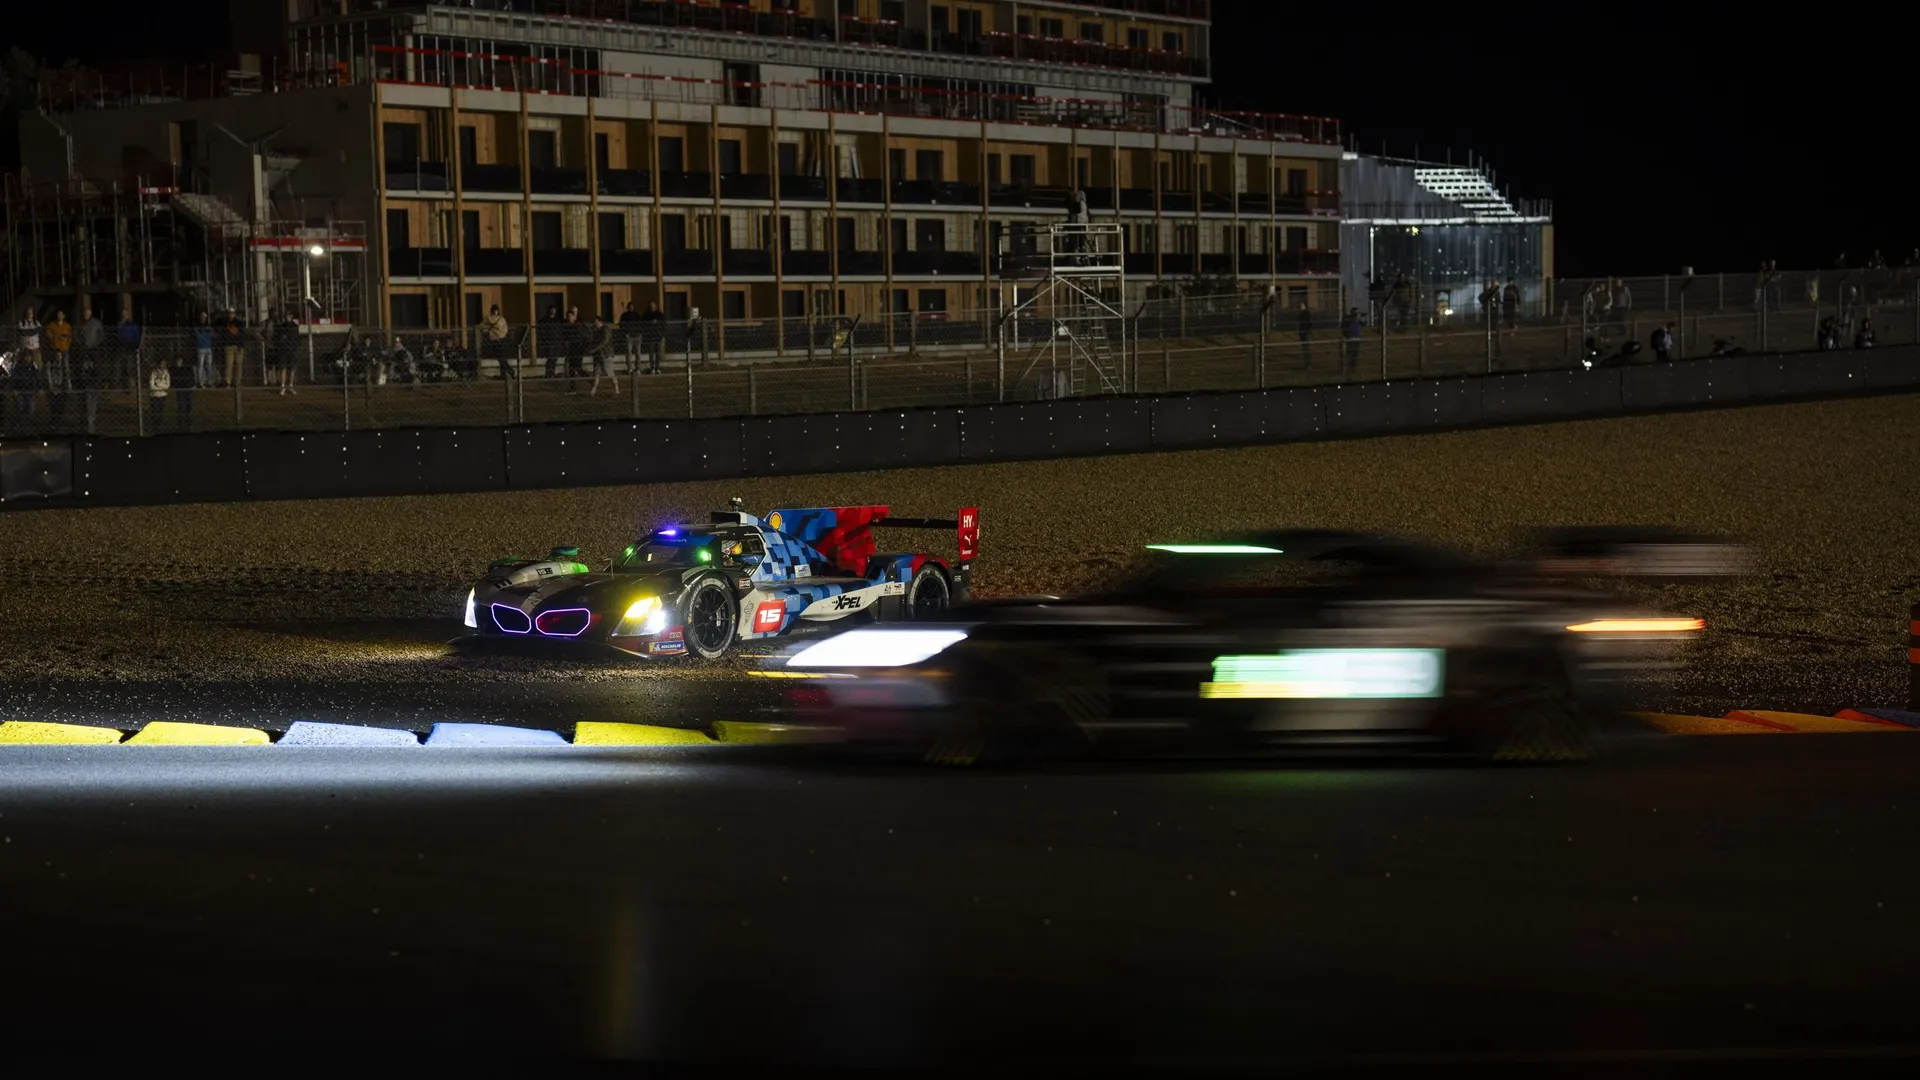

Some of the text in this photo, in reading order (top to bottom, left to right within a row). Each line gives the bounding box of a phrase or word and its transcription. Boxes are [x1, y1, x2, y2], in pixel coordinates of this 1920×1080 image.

[963, 515, 973, 528] HY
[834, 595, 861, 610] XPEL
[759, 608, 782, 624] 15
